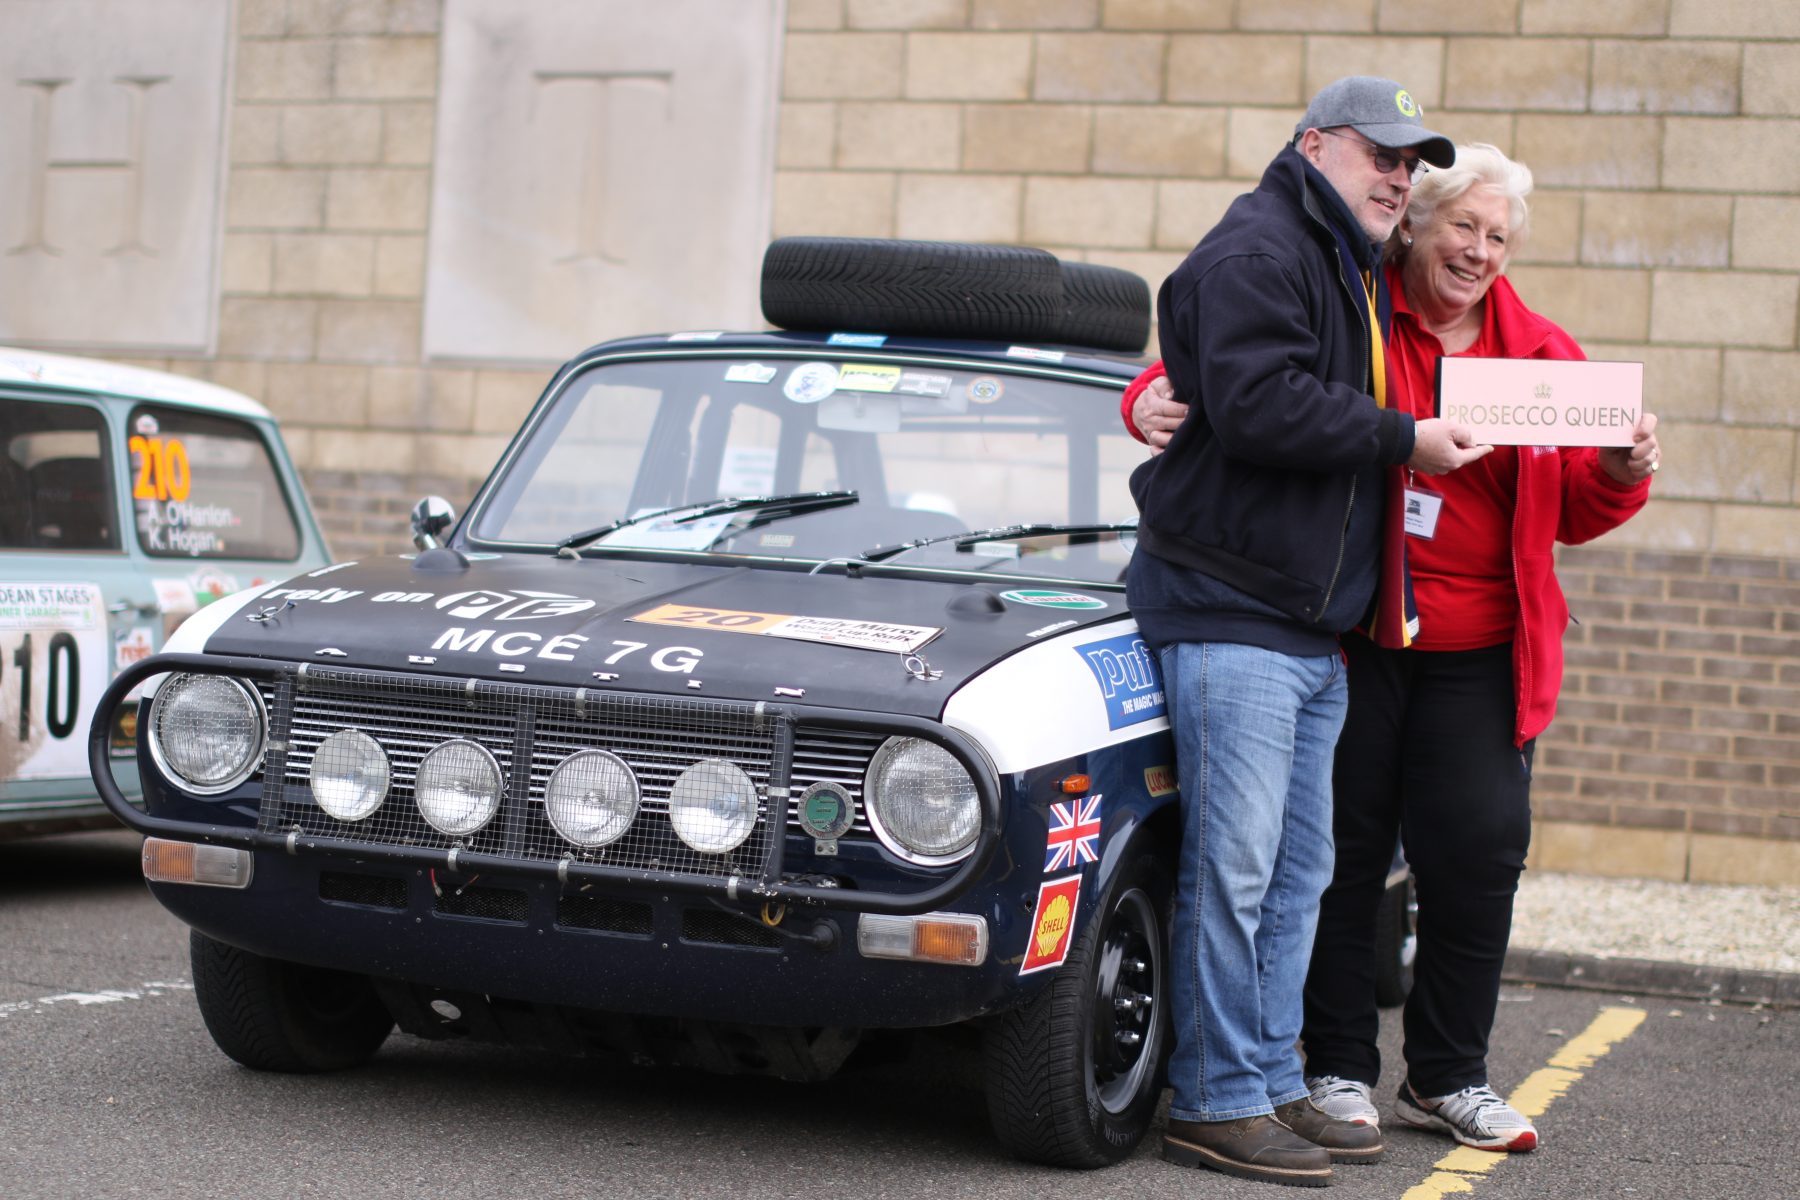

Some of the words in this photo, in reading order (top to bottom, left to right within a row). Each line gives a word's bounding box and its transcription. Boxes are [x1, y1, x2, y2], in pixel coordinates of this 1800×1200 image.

[4, 74, 173, 258] H
[526, 70, 675, 265] T
[1447, 404, 1557, 426] PROSECCO
[1565, 407, 1635, 427] QUEEN
[128, 434, 191, 503] 210
[168, 528, 216, 557] Hogan
[39, 588, 90, 605] STAGES
[261, 587, 365, 603] rely
[371, 591, 435, 603] on
[1022, 595, 1090, 603] Castrol
[667, 611, 765, 627] 20
[797, 617, 851, 629] Daily
[856, 622, 926, 635] Mirror
[785, 622, 834, 633] World
[839, 627, 867, 637] Cup
[870, 630, 914, 642] Rally
[431, 627, 590, 662] MCE
[604, 640, 704, 674] 7G
[0, 632, 80, 742] 10
[1121, 700, 1135, 715] THE
[1133, 694, 1153, 712] MAGIC
[1041, 917, 1065, 935] SHELL
